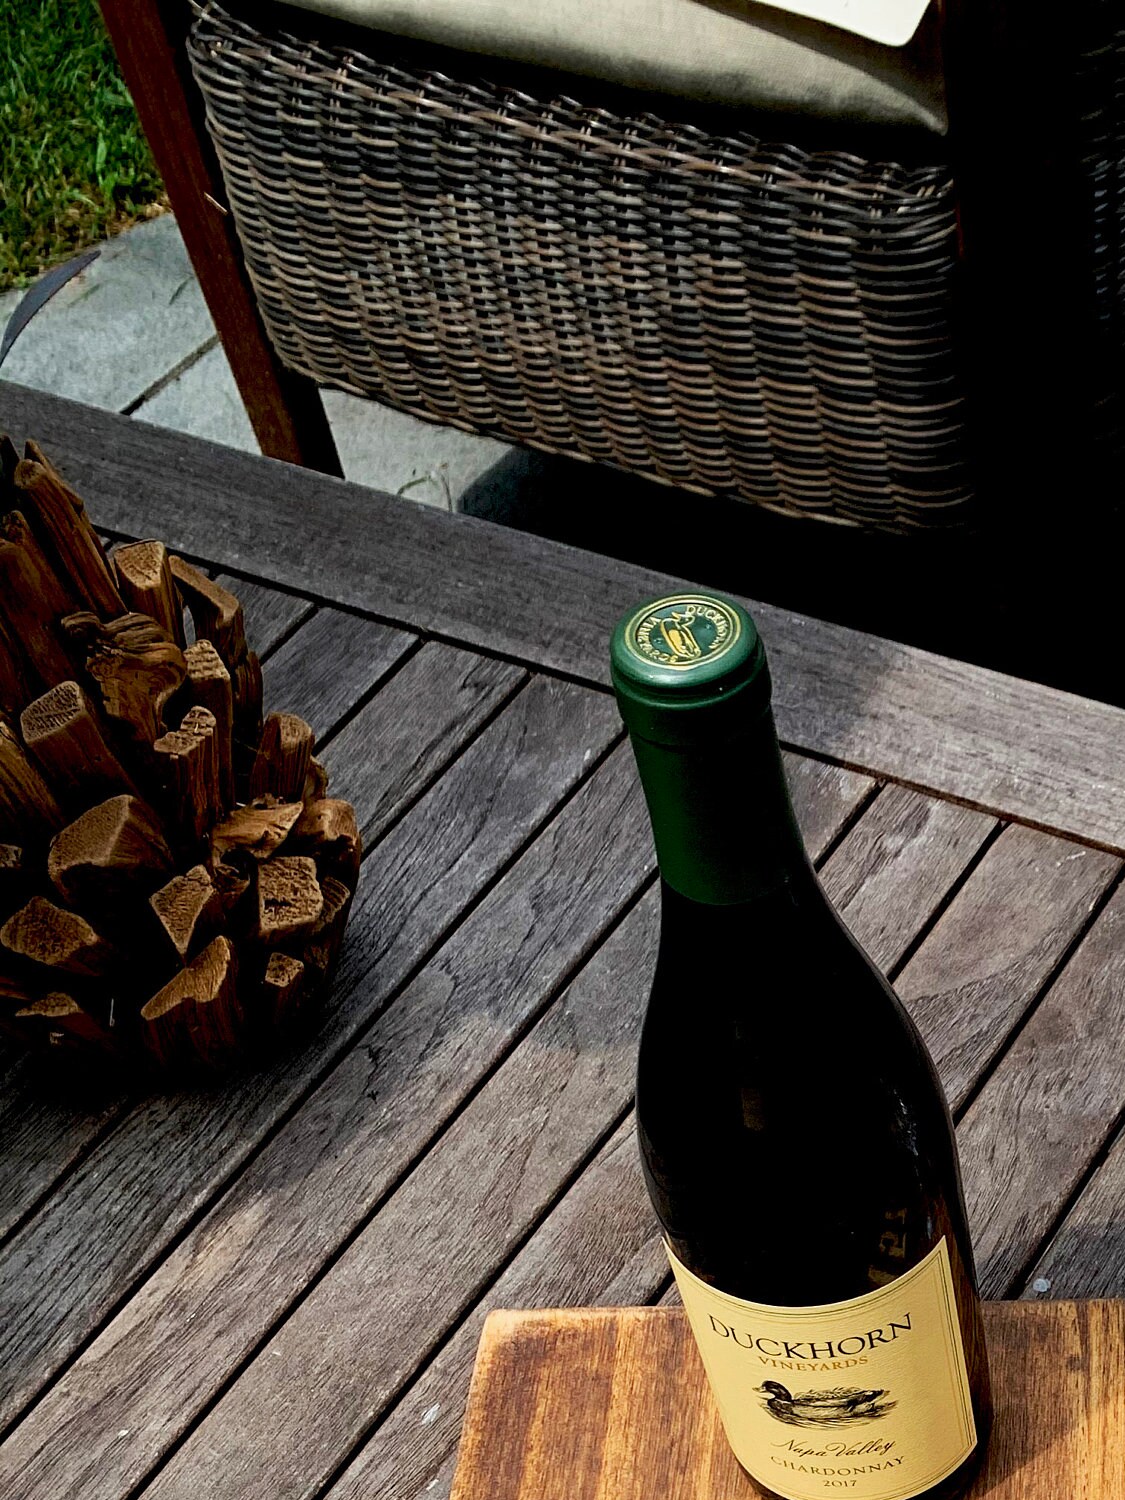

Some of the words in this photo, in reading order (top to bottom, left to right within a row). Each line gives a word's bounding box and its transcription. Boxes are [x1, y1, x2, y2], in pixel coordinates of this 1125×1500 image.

[708, 1312, 912, 1359] DUCKHORN
[758, 1355, 868, 1371] VINEYARDS
[771, 1438, 828, 1457] Napa
[826, 1438, 896, 1457] Valley
[771, 1455, 904, 1476] CHARDONNAY
[823, 1479, 857, 1487] 2017
